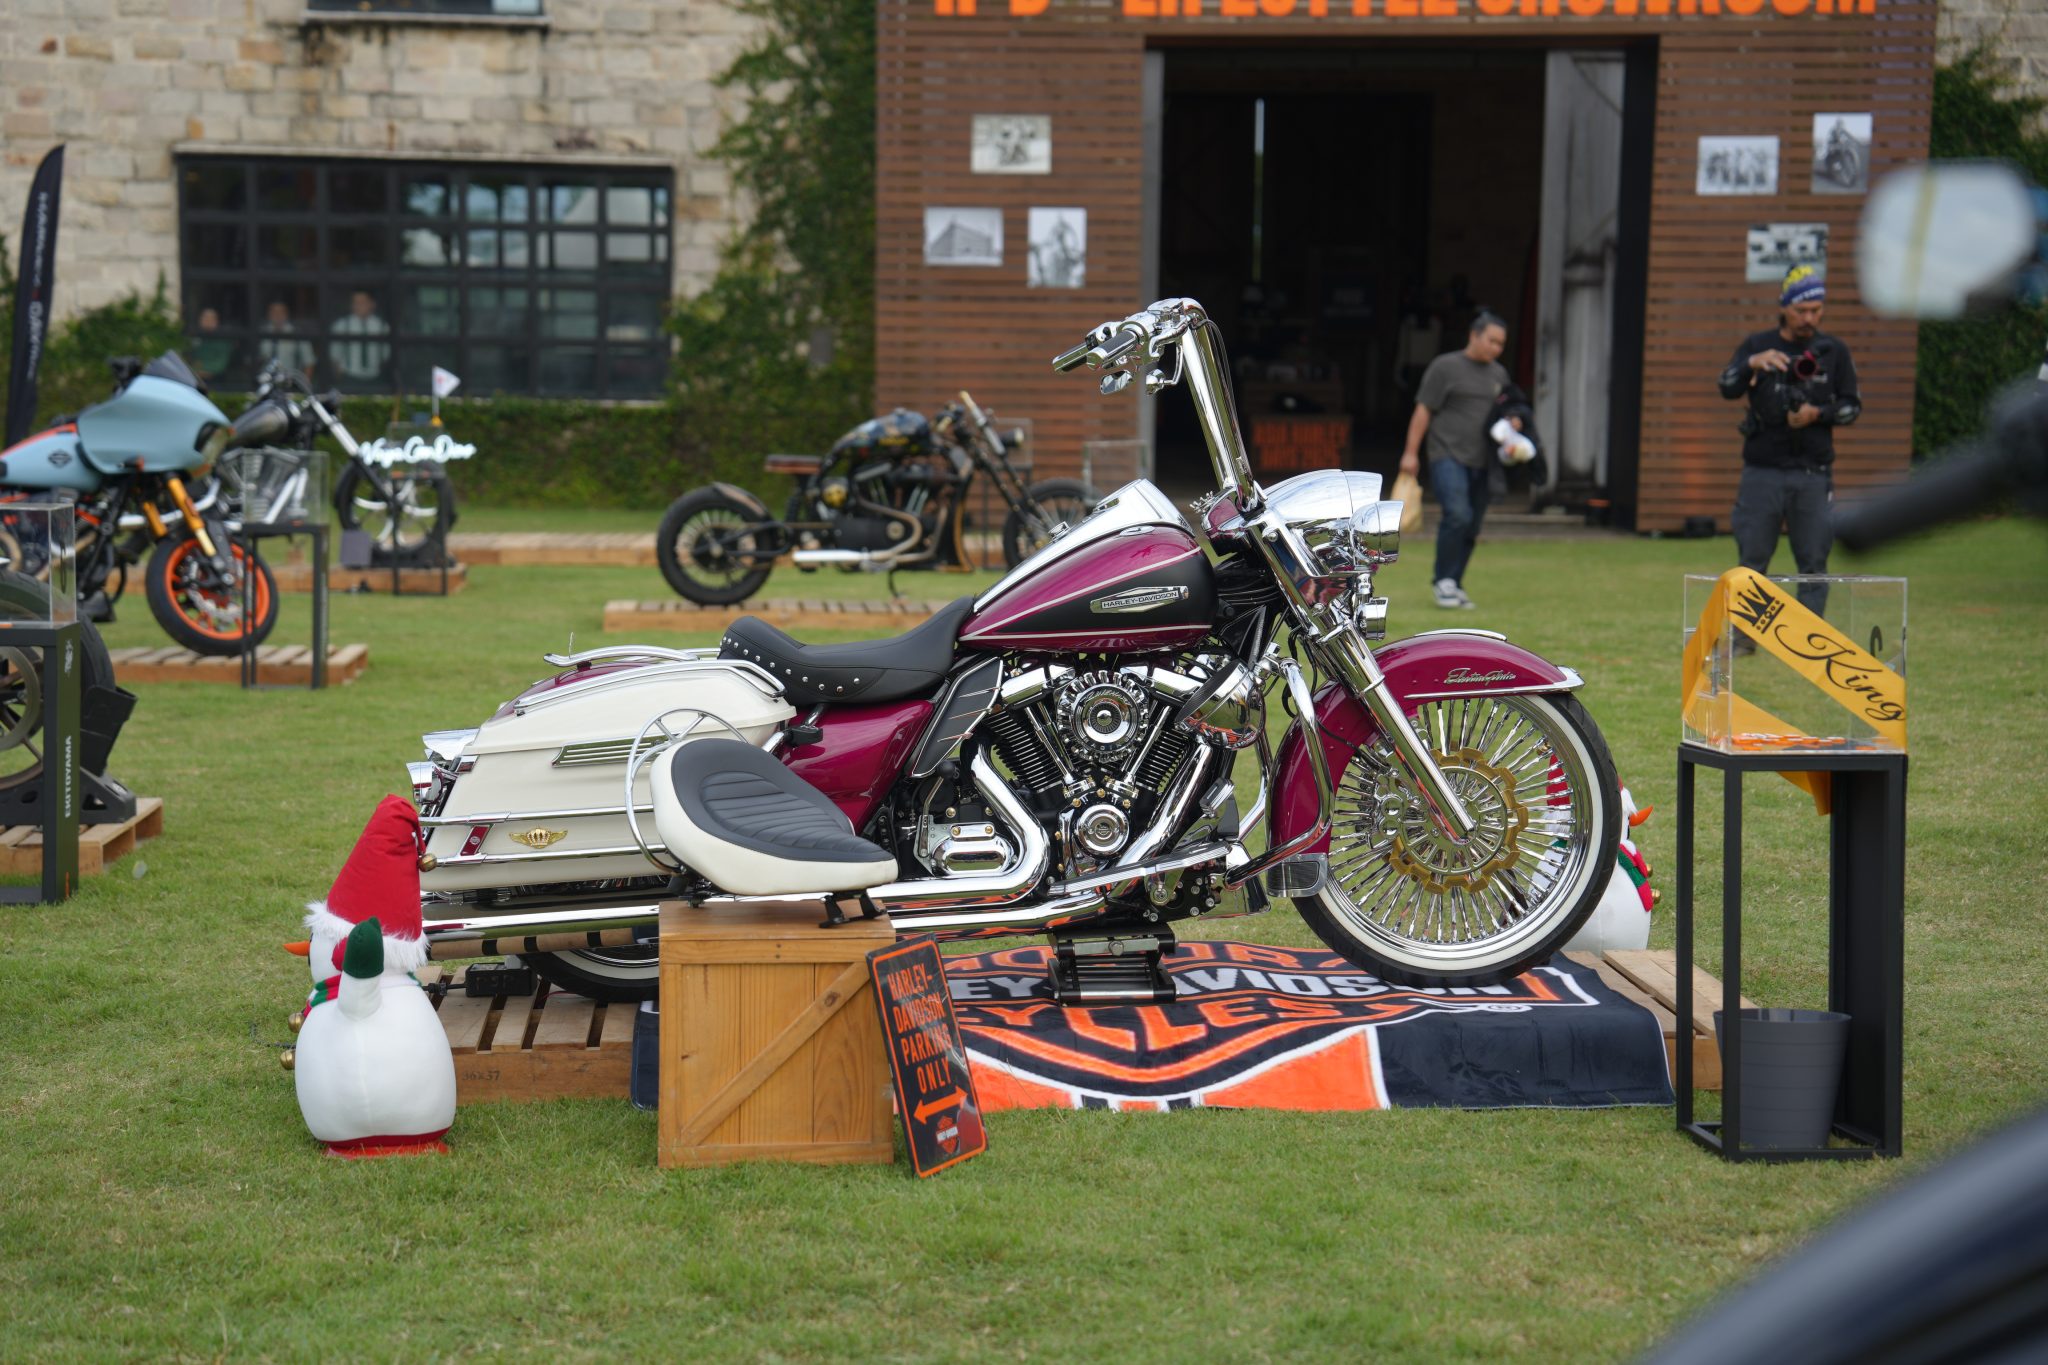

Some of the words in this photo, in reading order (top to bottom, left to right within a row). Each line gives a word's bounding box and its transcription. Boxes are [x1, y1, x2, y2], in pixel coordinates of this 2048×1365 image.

[1102, 591, 1178, 608] HARLEY-DAVIDSON
[1773, 623, 1906, 722] King
[888, 962, 934, 1001] HARLEY-
[893, 991, 947, 1034] DAVIDSON
[901, 1023, 953, 1066] PARKING
[917, 1056, 952, 1095] ONLY
